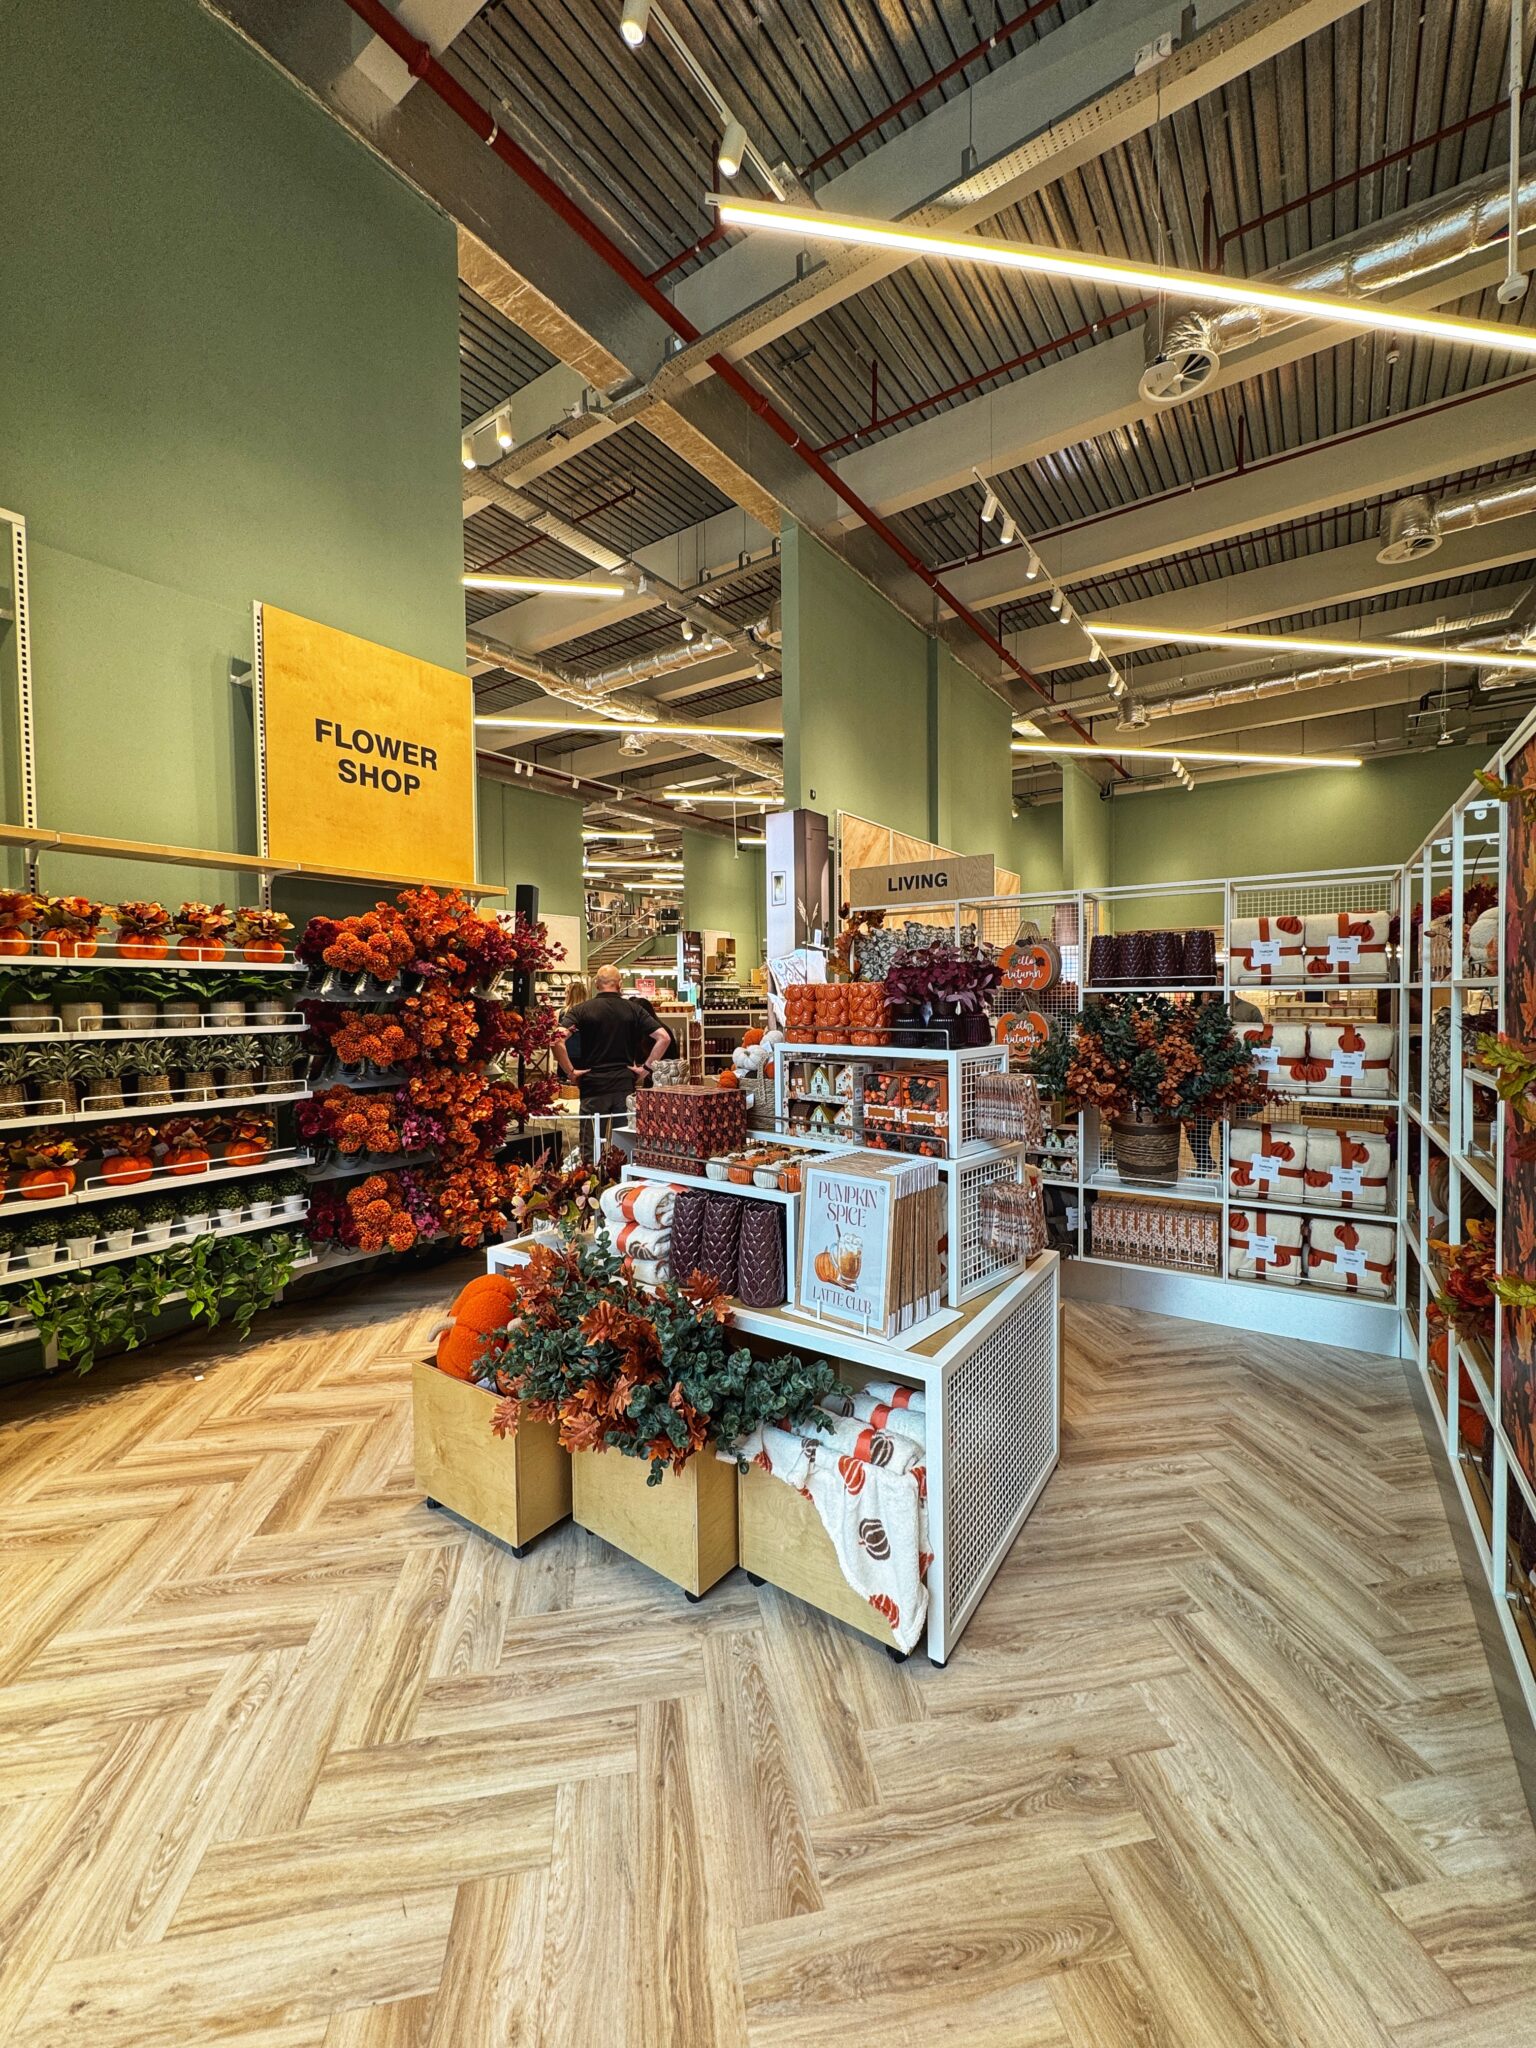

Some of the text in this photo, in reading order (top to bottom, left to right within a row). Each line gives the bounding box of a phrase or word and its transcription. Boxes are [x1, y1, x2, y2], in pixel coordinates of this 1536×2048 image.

[315, 717, 438, 772] FLOWER
[338, 758, 421, 796] SHOP
[887, 872, 948, 892] LIVING
[1003, 969, 1043, 979] Autumn
[818, 1180, 878, 1209] PUMPKIN
[826, 1202, 867, 1228] SPICE
[812, 1284, 872, 1315] LATTE CLUB
